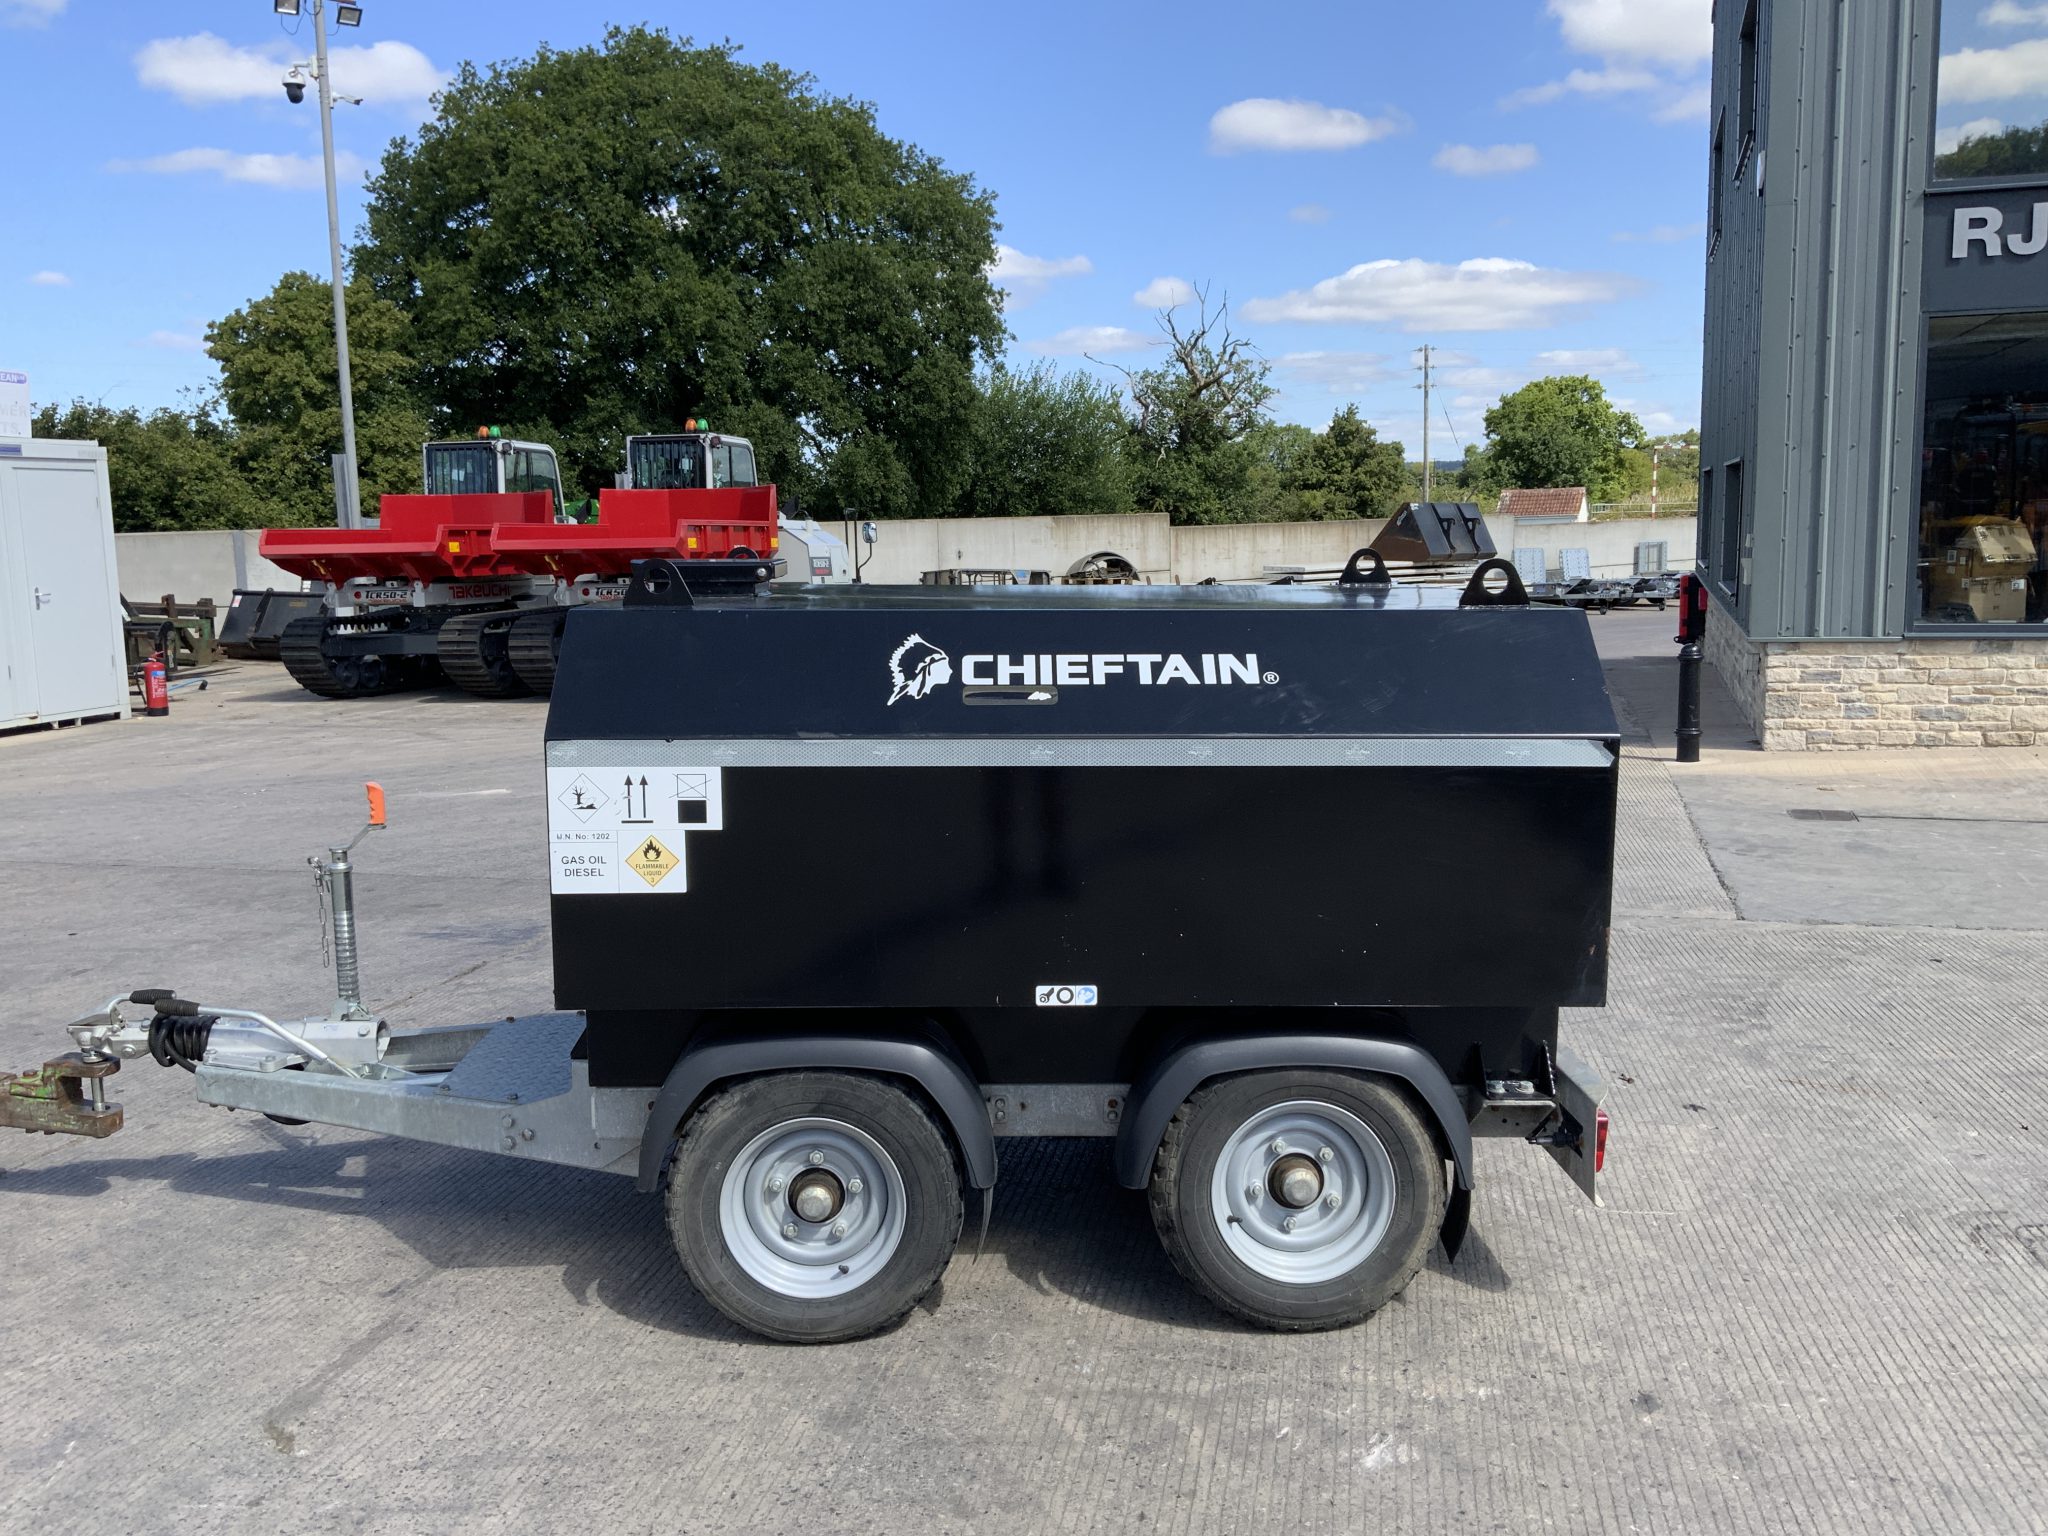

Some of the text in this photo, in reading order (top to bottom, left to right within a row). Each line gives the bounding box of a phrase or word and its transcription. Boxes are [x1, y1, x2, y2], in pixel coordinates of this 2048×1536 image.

[1952, 202, 2048, 258] RJ
[961, 653, 1260, 685] CHIEFTAIN
[592, 832, 610, 840] 1202
[561, 855, 607, 865] GAS OIL
[564, 868, 605, 877] DIESEL
